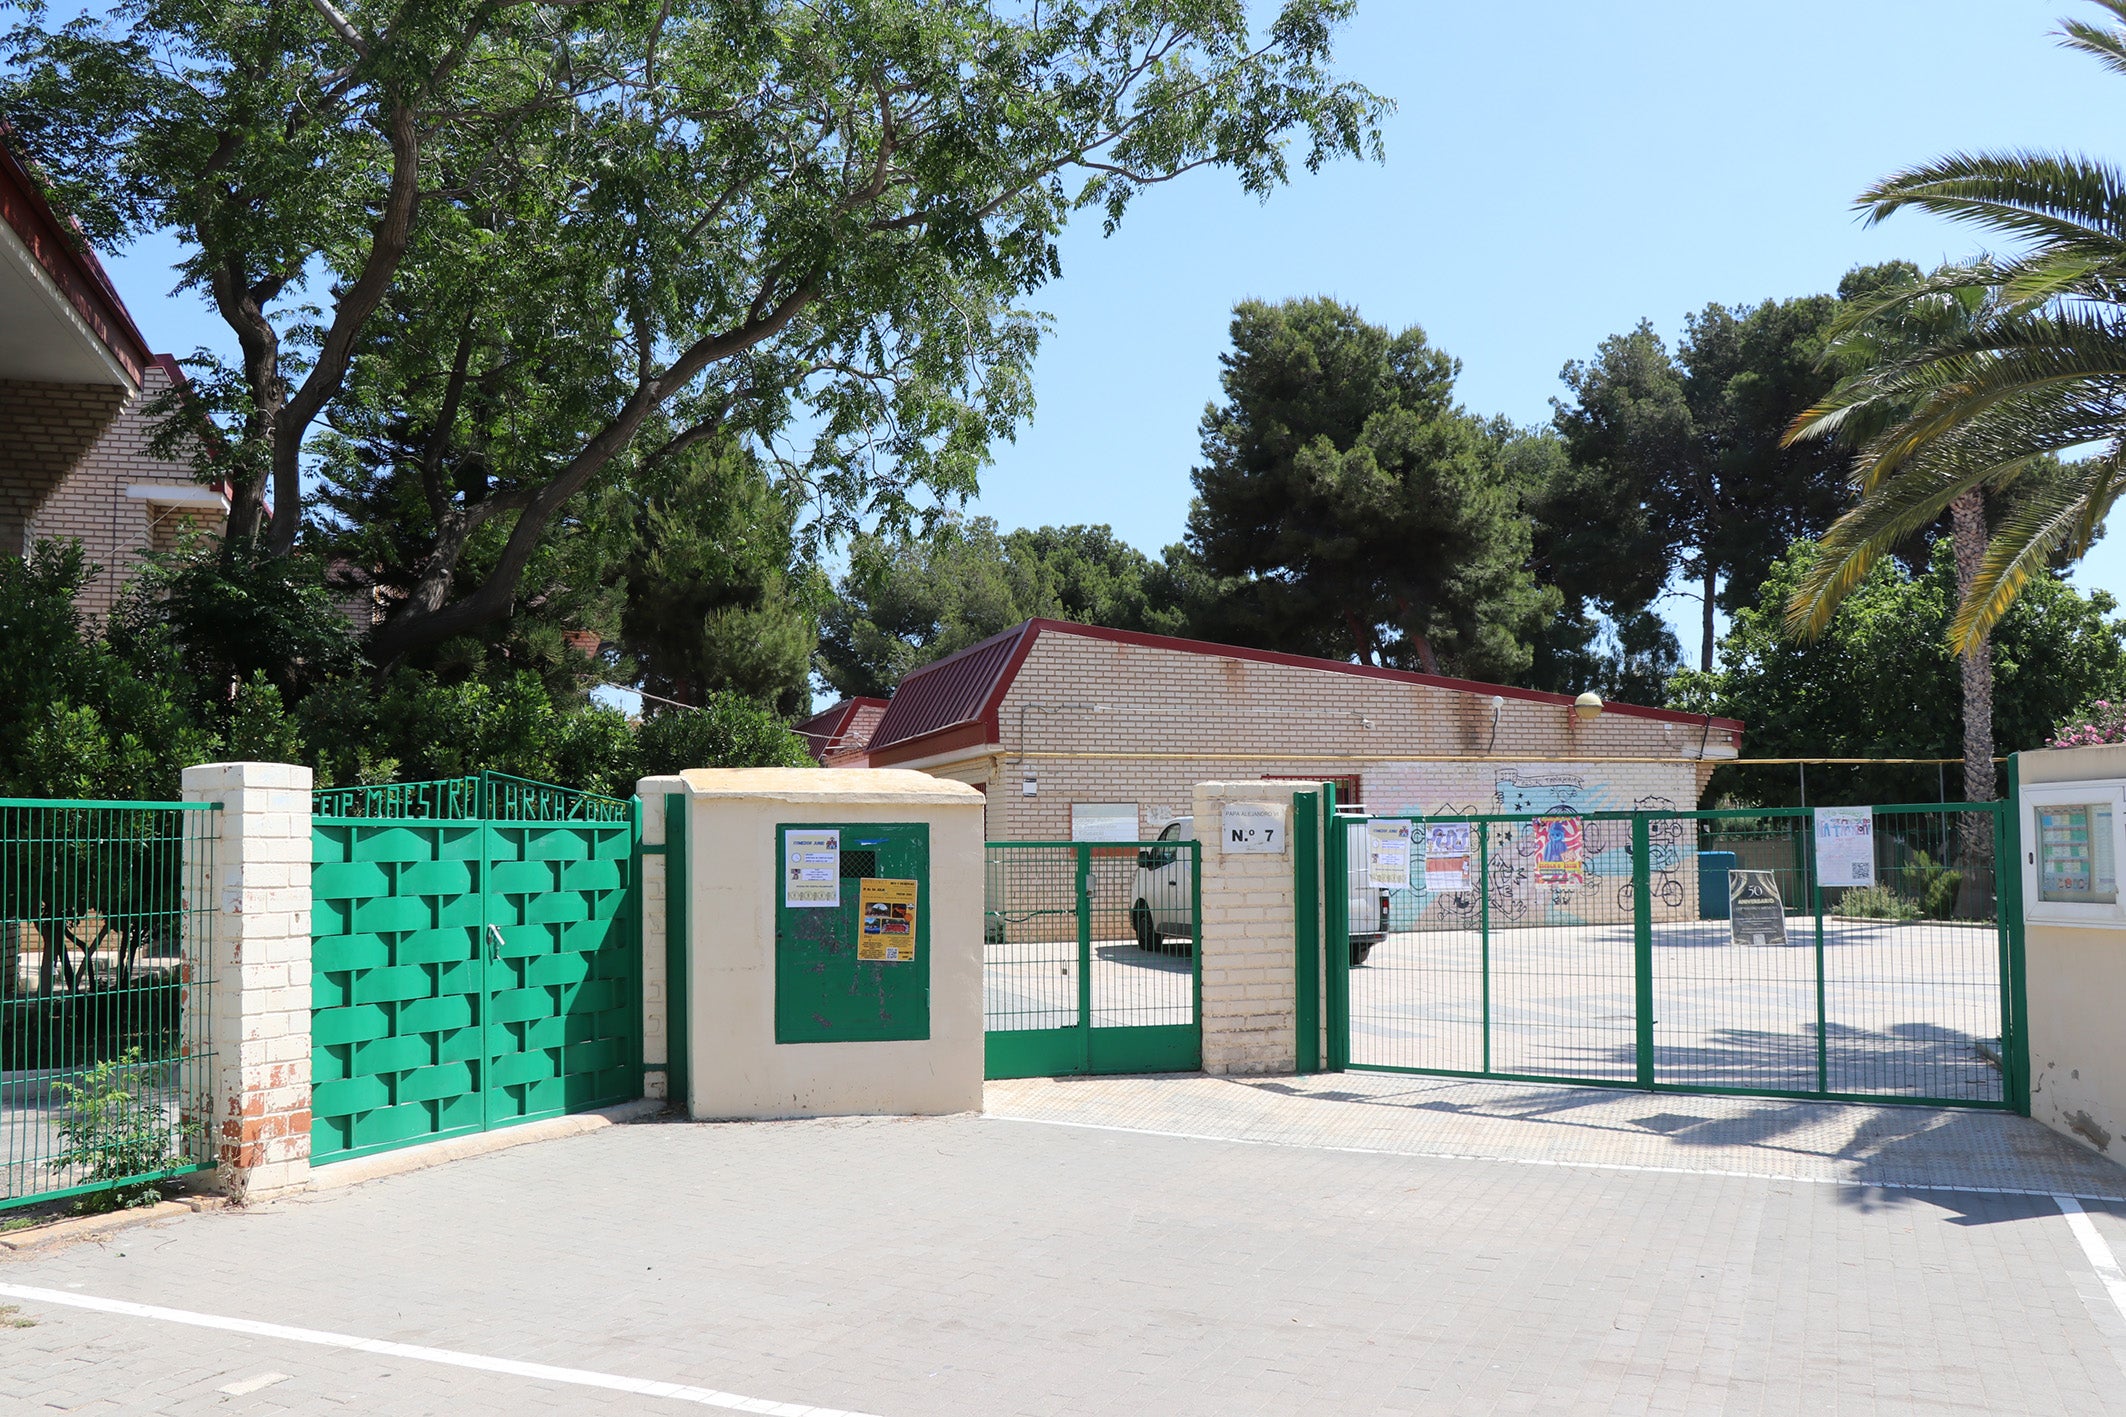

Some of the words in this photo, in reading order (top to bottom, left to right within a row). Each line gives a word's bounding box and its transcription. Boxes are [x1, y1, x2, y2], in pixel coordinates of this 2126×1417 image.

[365, 776, 480, 820] MAESTRO
[487, 780, 624, 821] TARRAZONA
[1264, 829, 1274, 842] 7
[1748, 885, 1763, 898] 50
